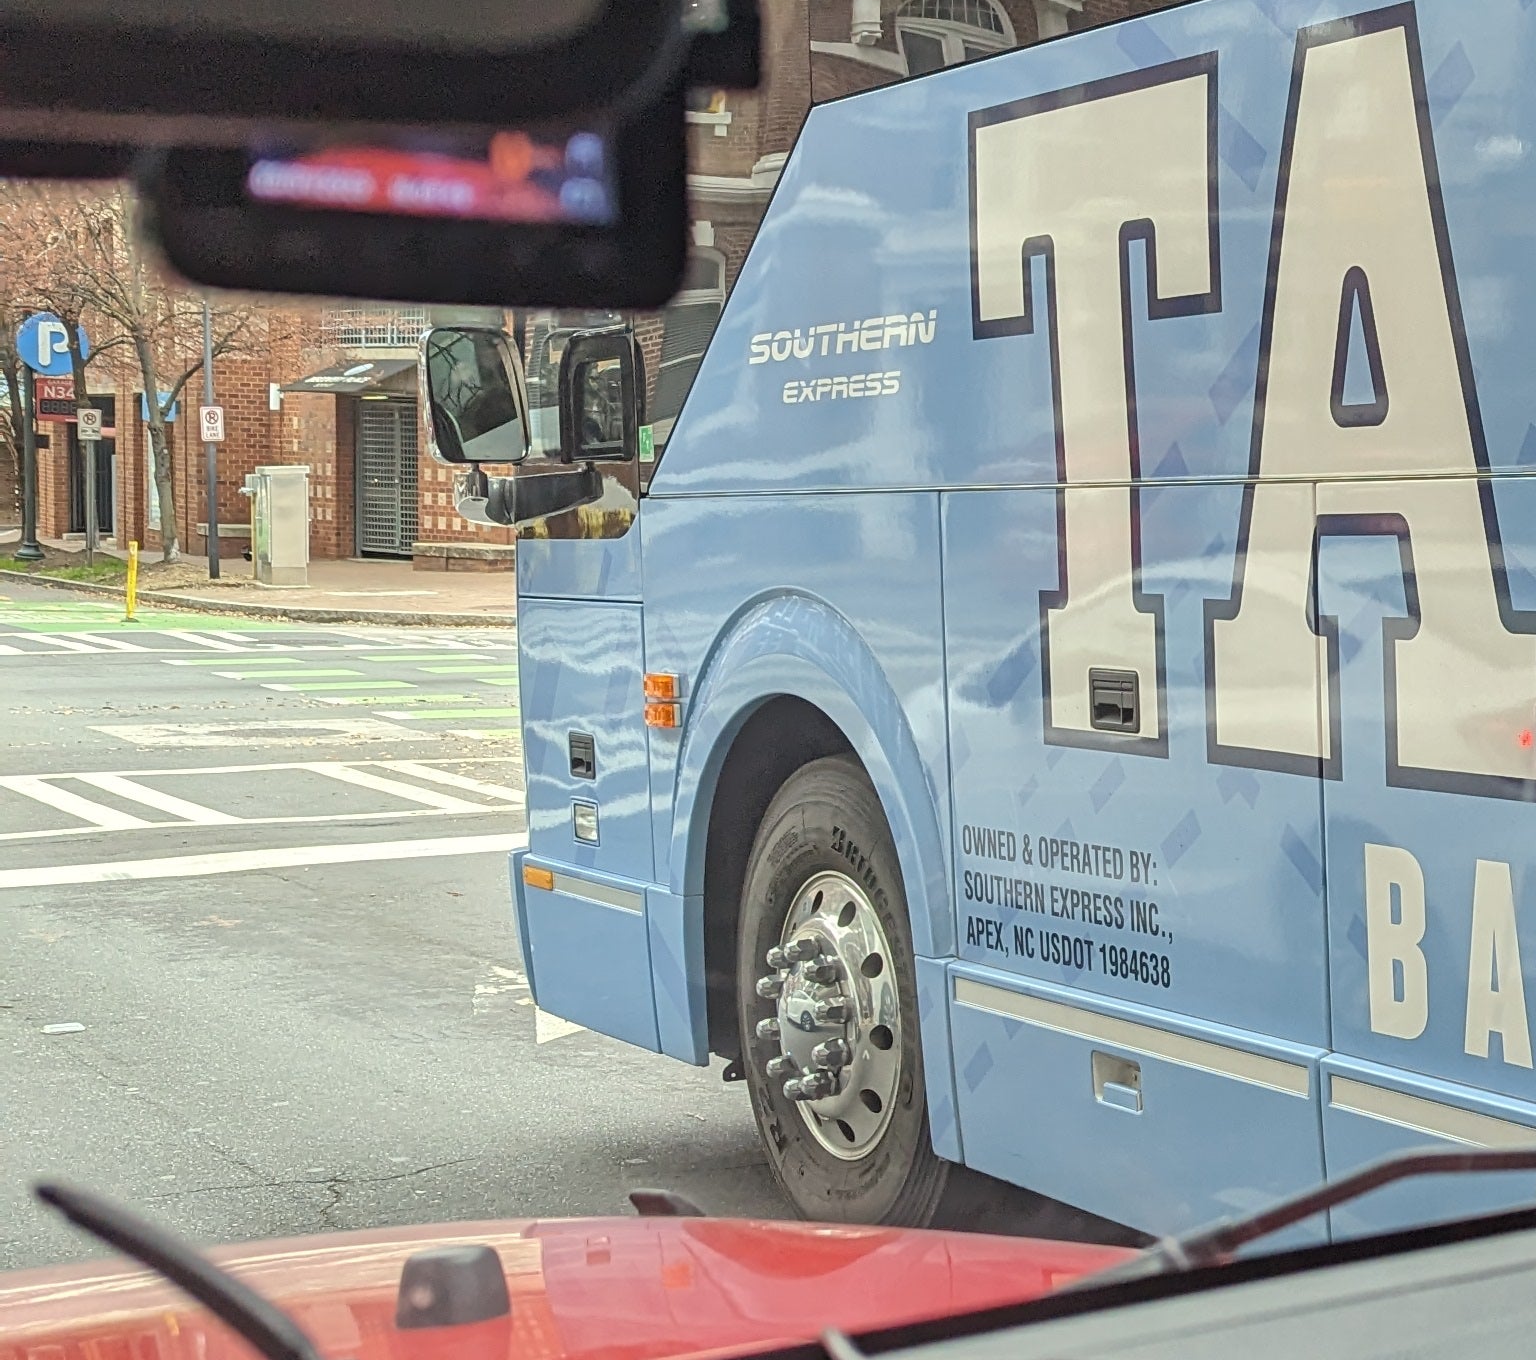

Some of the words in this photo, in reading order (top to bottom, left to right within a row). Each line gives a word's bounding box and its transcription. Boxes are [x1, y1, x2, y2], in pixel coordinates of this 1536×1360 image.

[38, 321, 69, 366] P
[749, 309, 937, 364] SOUTHERN
[44, 385, 76, 400] N34
[782, 370, 901, 404] EXPRESS
[962, 824, 1016, 862] OWNED
[1022, 833, 1033, 866] &
[1038, 836, 1124, 880] OPERATED
[1130, 850, 1158, 886] BY:
[964, 870, 1046, 914] SOUTHERN
[1050, 885, 1125, 929] EXPRESS
[1130, 899, 1173, 945] INC.,
[967, 915, 1009, 958] APEX,
[1013, 924, 1035, 959] NC
[1039, 930, 1094, 971] USDOT
[1099, 943, 1171, 989] 1984638
